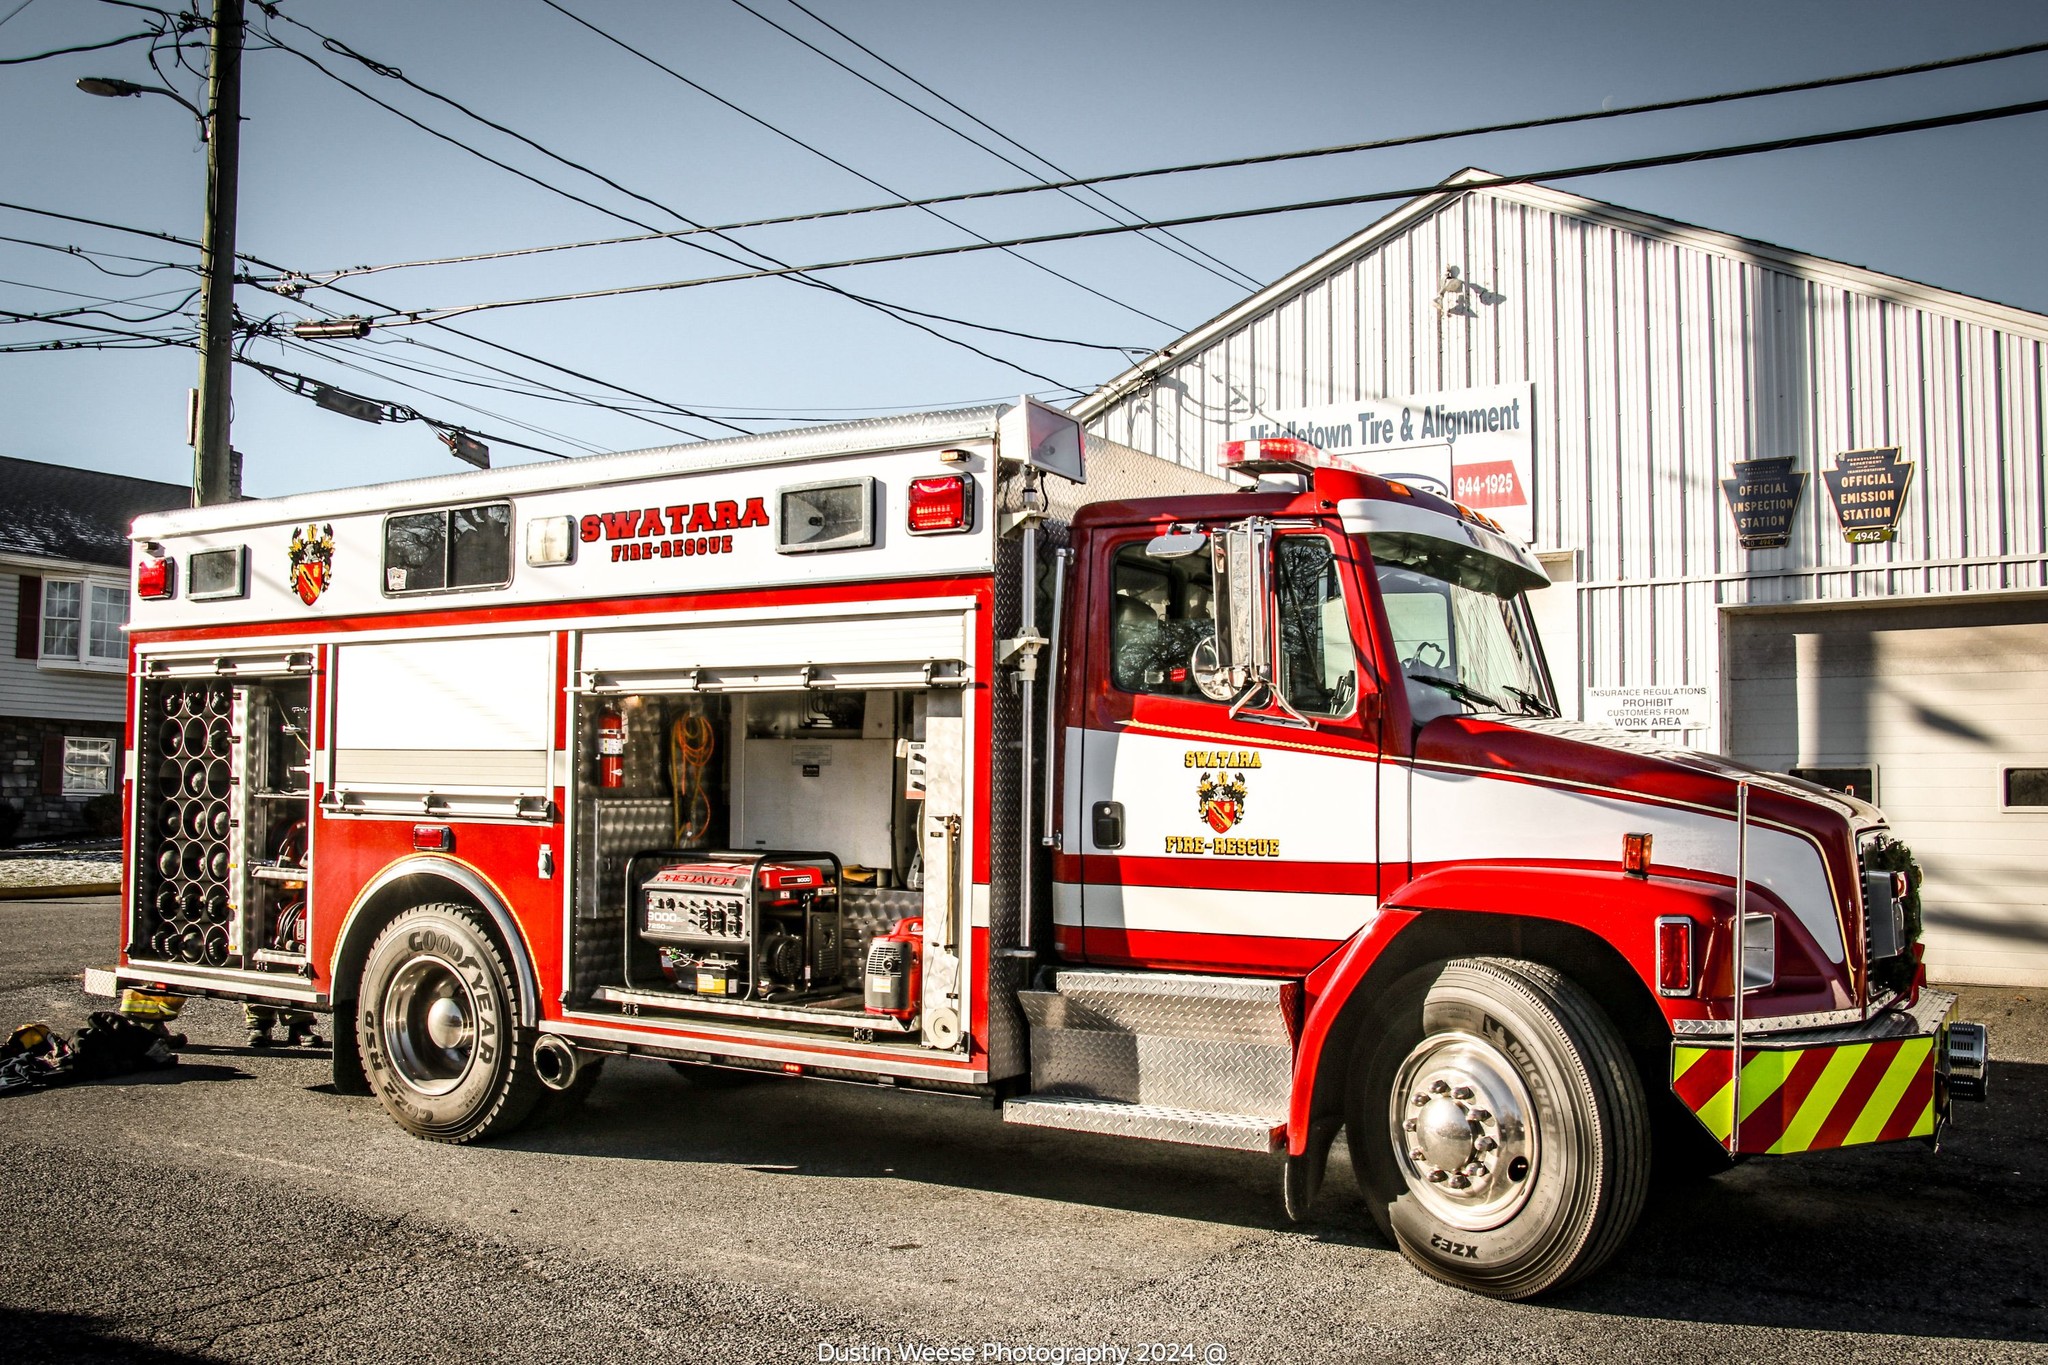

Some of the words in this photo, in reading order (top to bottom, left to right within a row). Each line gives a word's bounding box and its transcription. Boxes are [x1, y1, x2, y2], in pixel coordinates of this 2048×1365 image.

[1358, 411, 1394, 445] Tire
[1400, 406, 1415, 441] &
[1421, 397, 1520, 444] Alignment
[1457, 472, 1513, 497] 944-1925
[1841, 473, 1894, 488] OFFICIAL
[1739, 484, 1788, 496] OFFICIAL
[1840, 489, 1895, 505] EMISSION
[1733, 498, 1793, 513] INSPECTION
[580, 497, 769, 542] SWATARA
[1843, 506, 1891, 521] STATION
[1740, 515, 1785, 529] STATION
[1854, 531, 1881, 541] 4942
[611, 535, 733, 562] FIRE-RESCUE
[1591, 688, 1641, 697] INSURANCE
[1643, 687, 1707, 696] REGULATIONS
[1622, 698, 1673, 707] PROHIBIT
[1607, 708, 1661, 717] CUSTOMERS
[1664, 708, 1690, 716] FROM
[1614, 717, 1648, 726] WORK
[1651, 717, 1682, 726] AREA
[1184, 751, 1262, 769] SWATARA
[1165, 836, 1280, 857] FIRE-RESCUE
[656, 873, 738, 886] PREDATOR
[648, 911, 677, 922] 9000
[408, 930, 495, 1065] GOODYEAR
[365, 1010, 383, 1071] RSD
[1508, 1041, 1558, 1173] MICHELIN
[1430, 1233, 1479, 1259] XZE2
